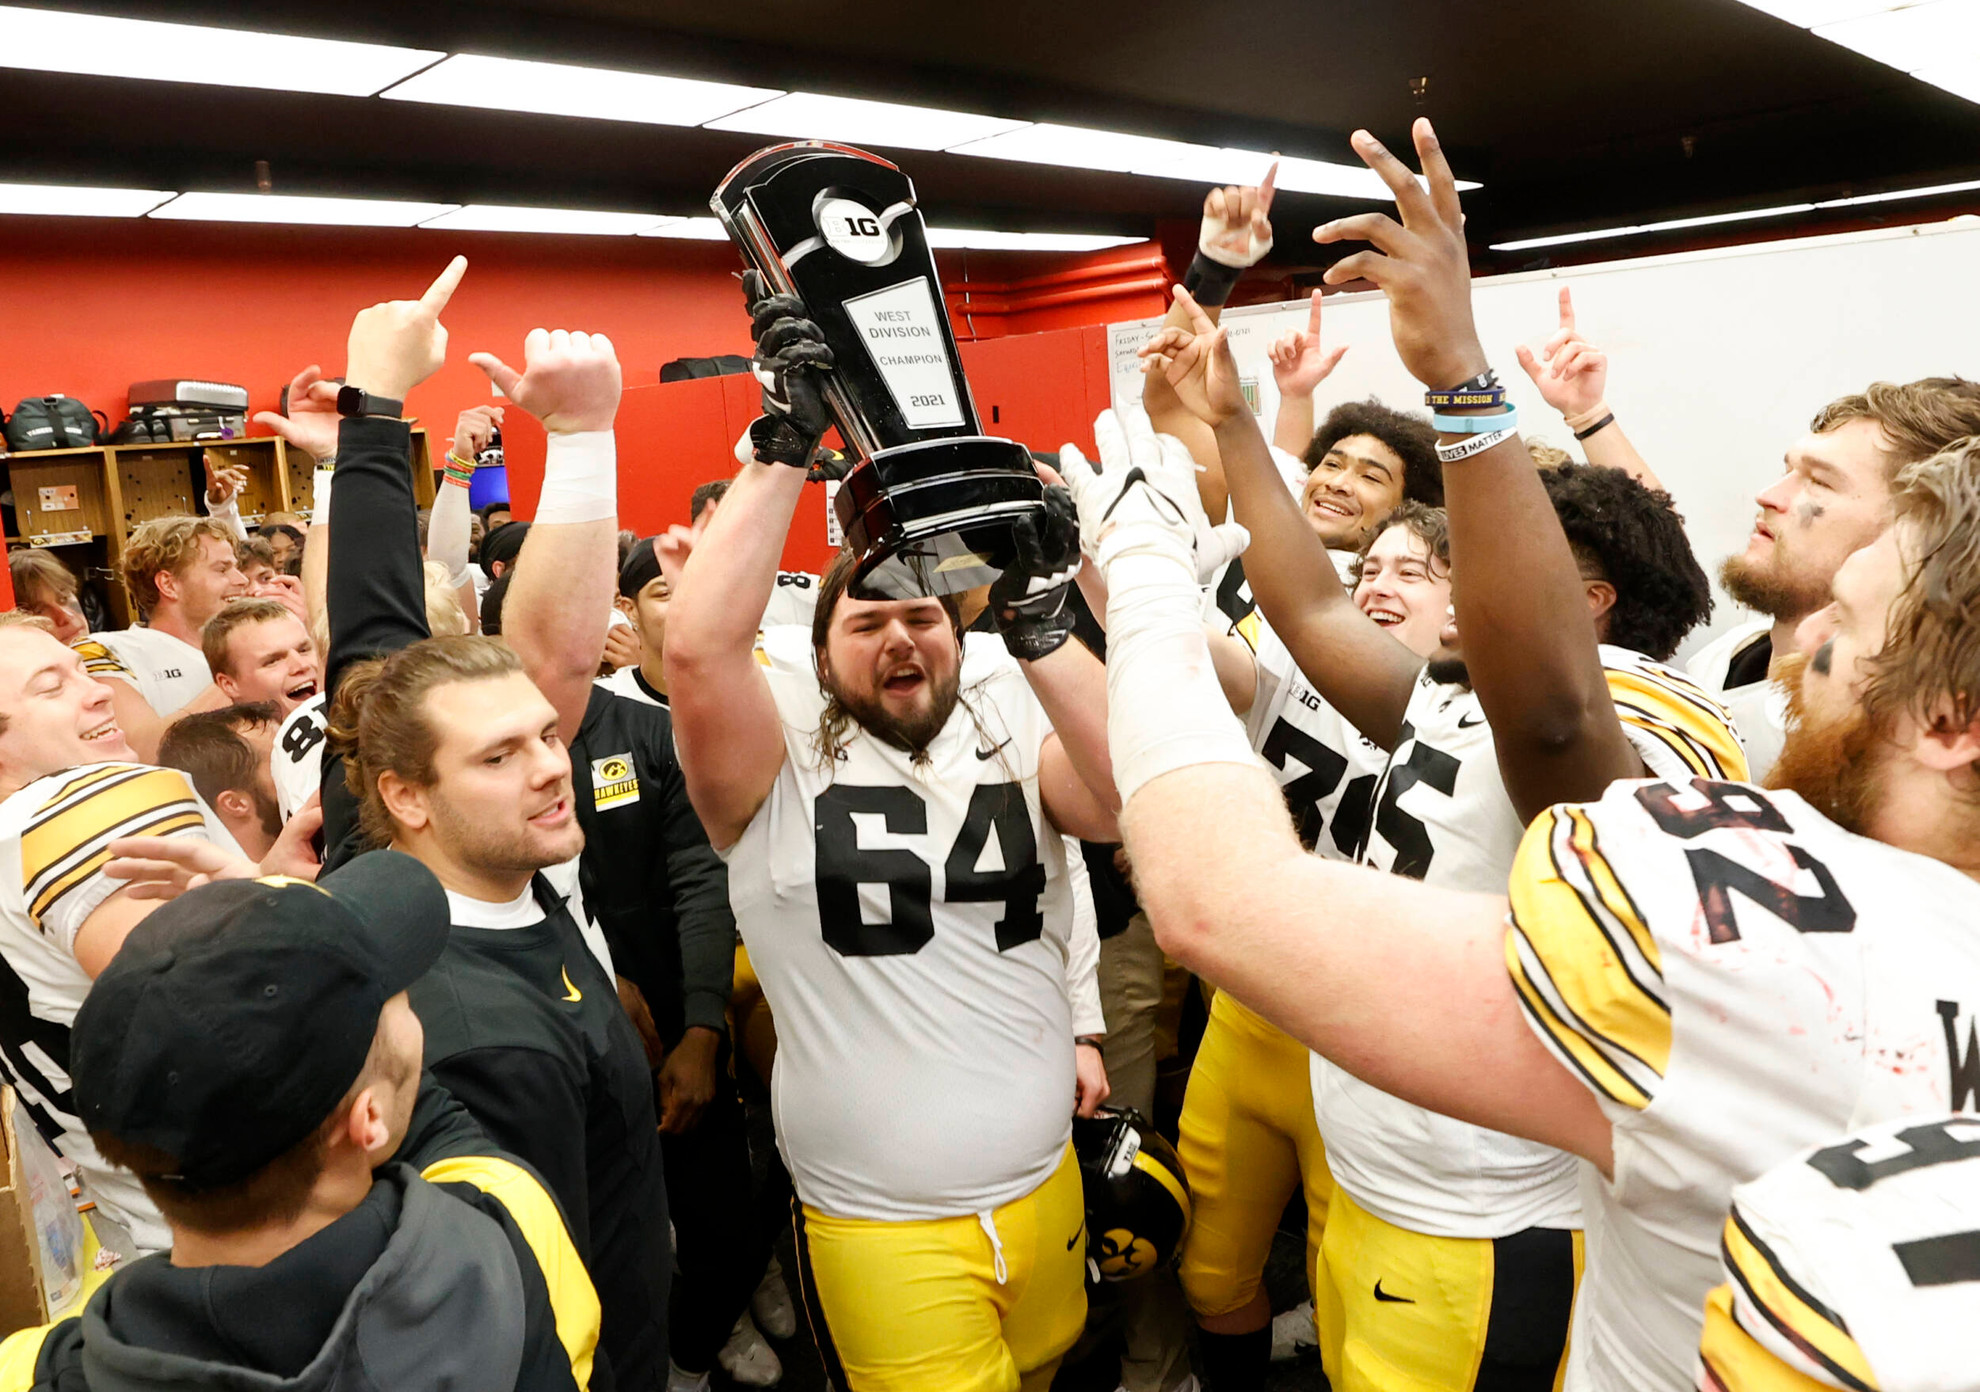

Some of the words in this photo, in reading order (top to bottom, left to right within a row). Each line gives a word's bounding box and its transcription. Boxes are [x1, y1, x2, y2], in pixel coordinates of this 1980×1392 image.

[874, 310, 912, 322] WEST
[869, 326, 931, 339] DIVISION
[879, 354, 943, 366] CHAMPION
[910, 394, 946, 407] 2021
[1431, 395, 1449, 404] THE
[1453, 394, 1493, 404] MISSION
[1468, 430, 1503, 452] MATTER
[593, 778, 639, 800] HAWKEYES
[814, 783, 1046, 957] 64
